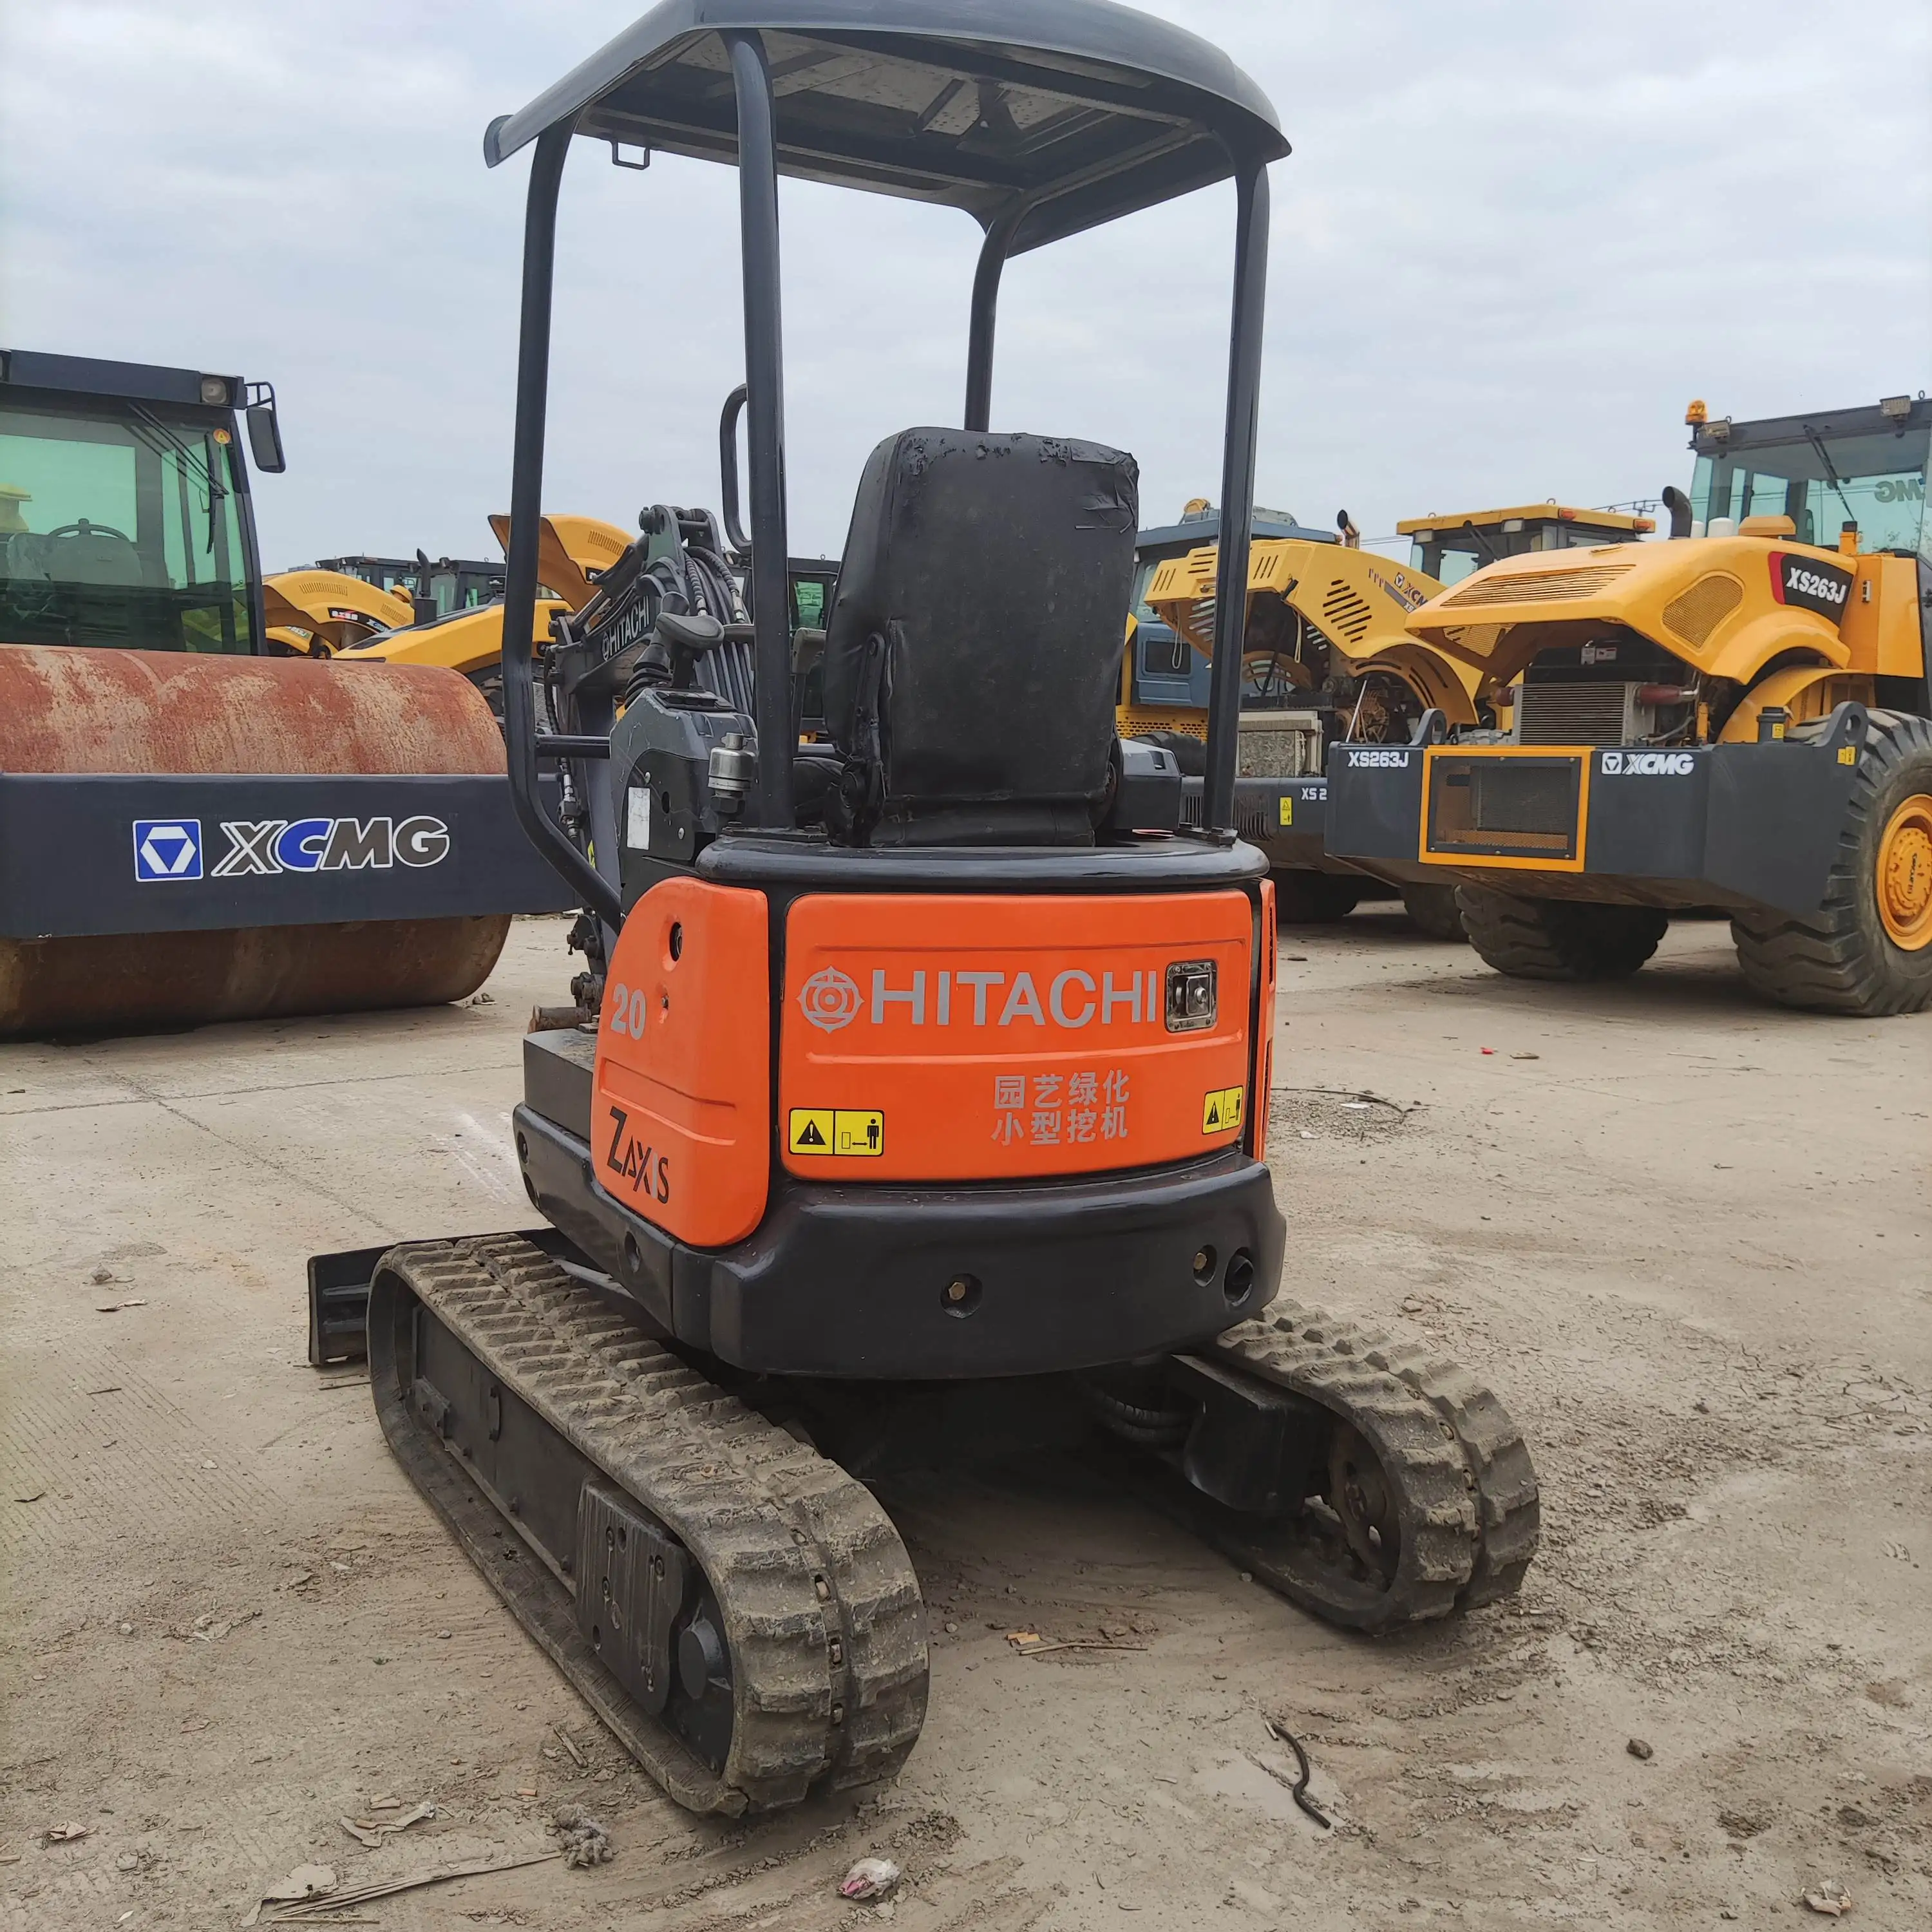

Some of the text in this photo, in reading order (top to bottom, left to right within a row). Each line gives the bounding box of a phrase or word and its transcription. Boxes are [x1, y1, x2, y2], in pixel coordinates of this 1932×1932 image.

[1786, 567, 1847, 604] XS263J
[609, 595, 649, 656] HITACHI
[1347, 751, 1409, 768] XS263J
[1622, 753, 1694, 775] XCMG
[211, 815, 450, 876] XCMG
[611, 983, 646, 1041] 20
[871, 969, 1157, 1028] HITACHI
[994, 1070, 1130, 1110] 园艺绿化
[991, 1106, 1128, 1146] 小型挖机
[607, 1105, 669, 1204] ZAXIS
